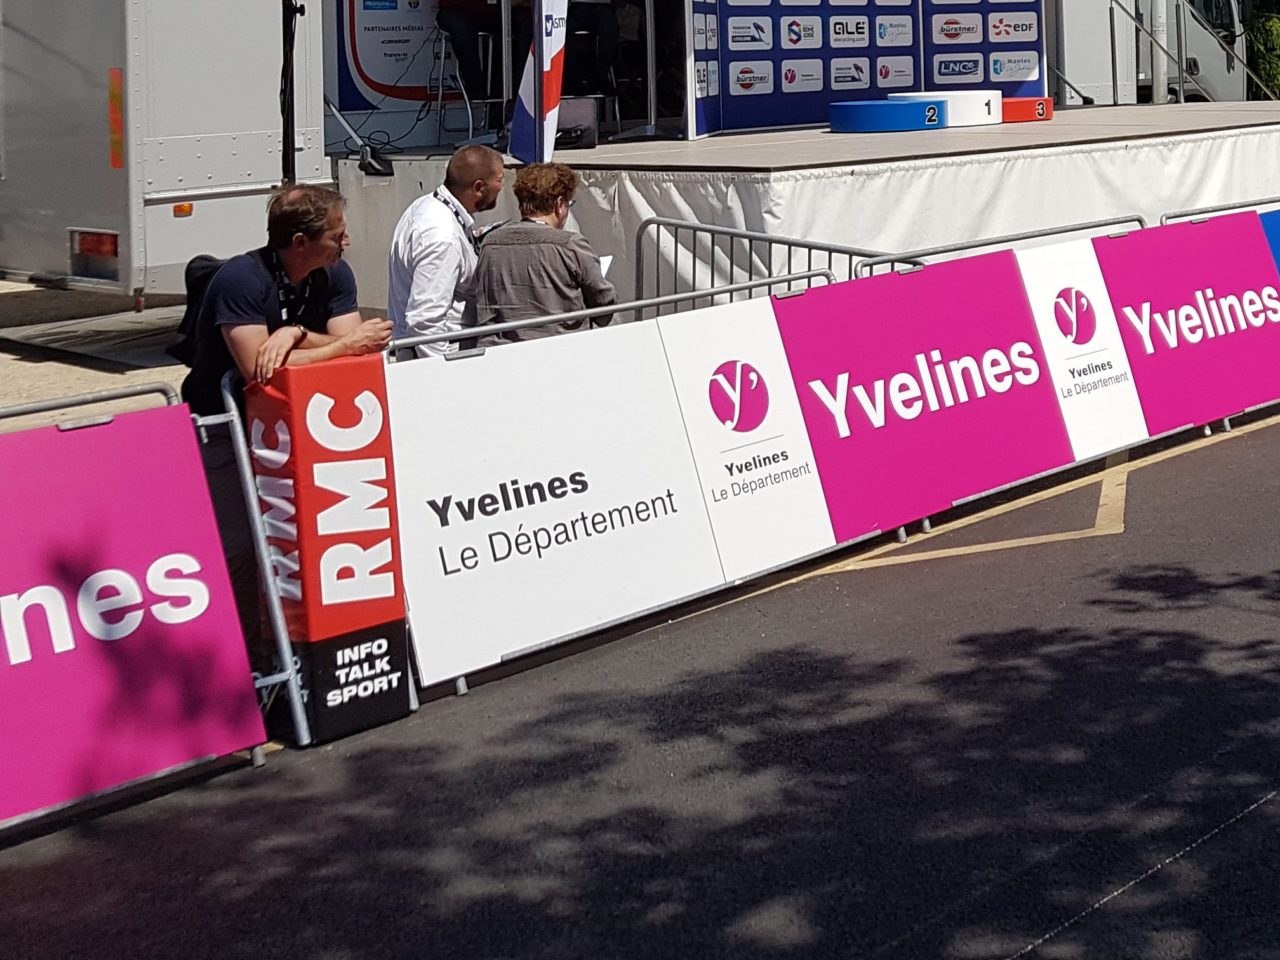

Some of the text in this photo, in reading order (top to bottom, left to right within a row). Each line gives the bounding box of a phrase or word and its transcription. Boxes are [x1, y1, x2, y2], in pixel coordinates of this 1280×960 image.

[402, 24, 424, 32] MÉDIAS
[940, 24, 975, 33] bürstner
[736, 73, 768, 84] bürstner
[926, 105, 938, 125] 2
[984, 99, 991, 116] 1
[1036, 101, 1046, 119] 3
[1068, 360, 1113, 379] Yvelines
[807, 340, 1040, 439] Yvelines
[1061, 370, 1129, 400] Le Département
[724, 448, 789, 478] Yvelines
[711, 461, 812, 503] Le Département
[306, 390, 395, 606] RMC
[426, 470, 589, 528] Yvelines
[438, 487, 678, 576] Le Département
[336, 638, 388, 665] INFO
[335, 659, 391, 686] TALK
[326, 671, 401, 708] SPORT
